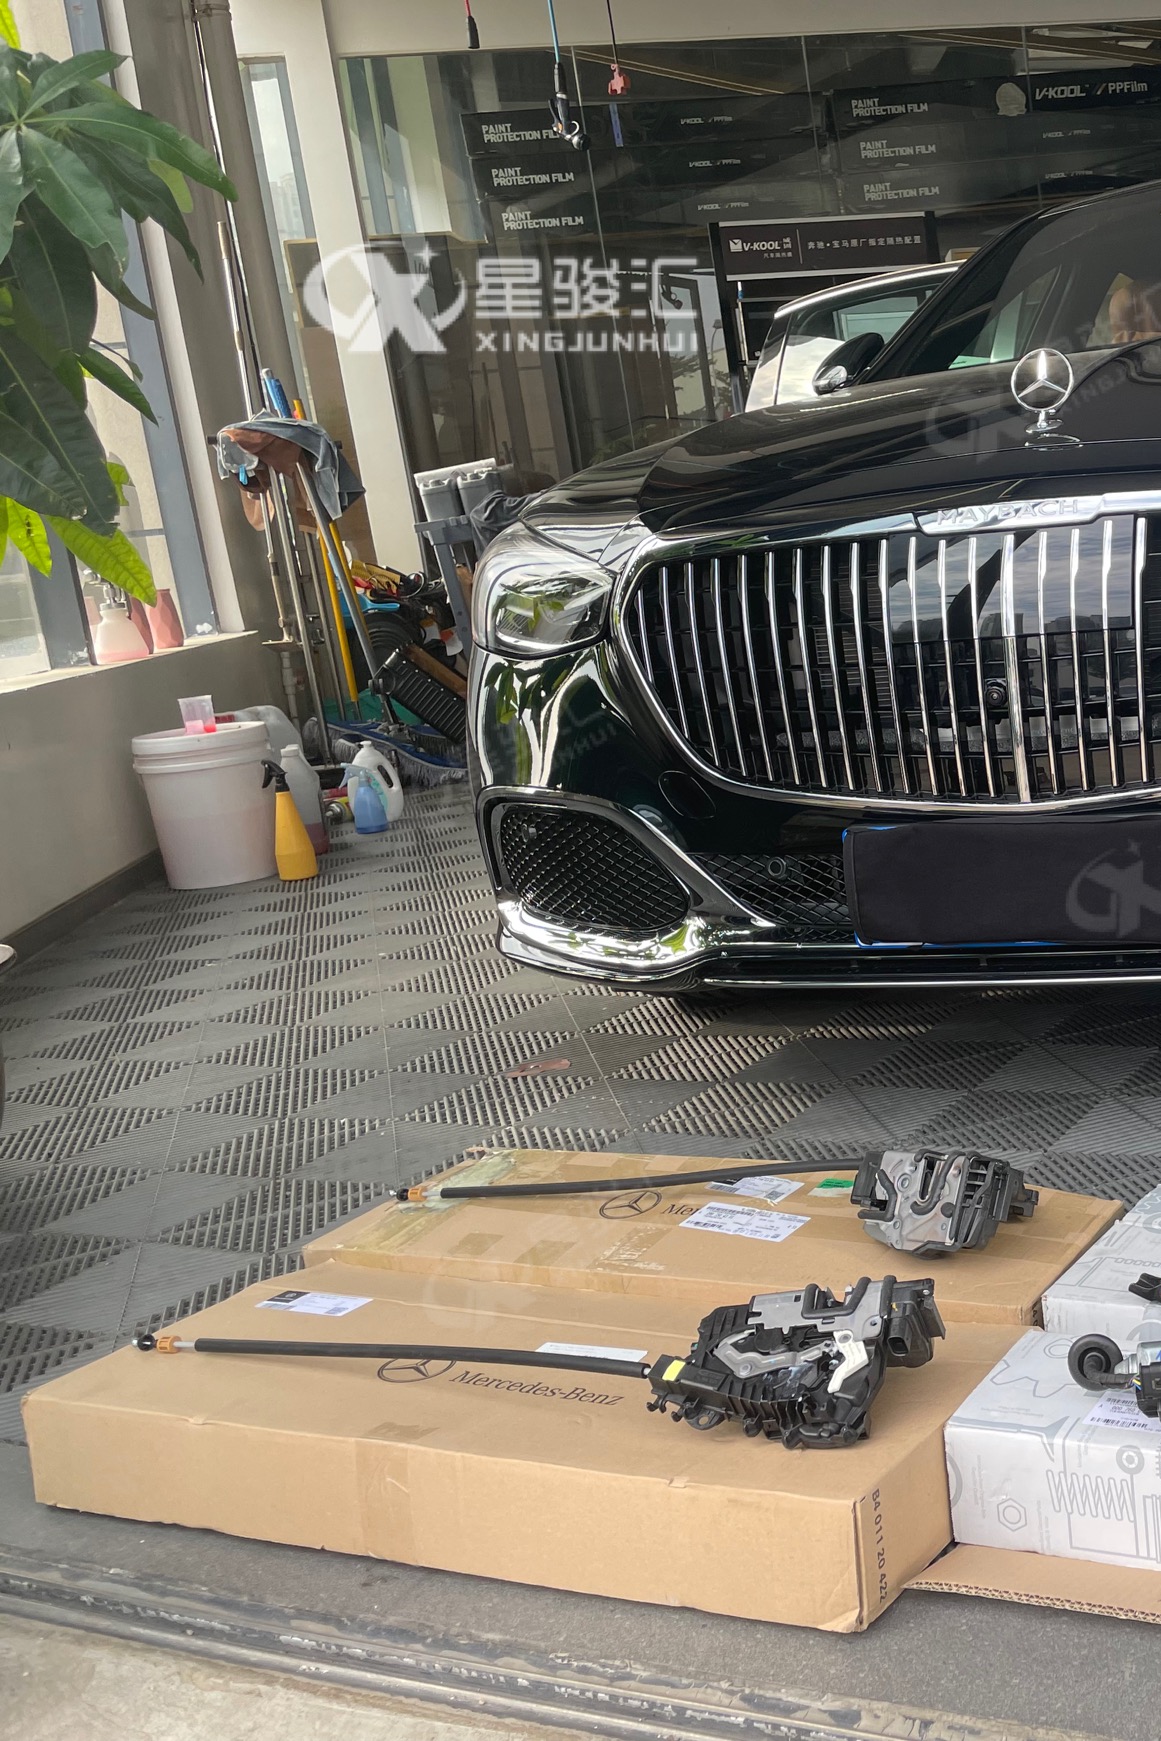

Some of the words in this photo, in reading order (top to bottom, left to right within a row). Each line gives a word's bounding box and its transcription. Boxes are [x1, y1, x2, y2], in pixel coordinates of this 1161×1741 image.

[1035, 84, 1086, 100] V-KOOL
[851, 97, 879, 108] PAINT
[852, 105, 906, 117] PROTECTION
[908, 103, 928, 113] FILM
[482, 123, 511, 134] PAINT
[484, 130, 540, 143] PROTECTION
[860, 139, 887, 150] PAINT
[861, 146, 914, 159] PROTECTION
[916, 144, 936, 155] FILM
[491, 167, 521, 178] PAINT
[493, 174, 550, 187] PROTECTION
[552, 172, 574, 184] FILM
[863, 182, 890, 193] PAINT
[865, 189, 917, 202] PROTECTION
[919, 186, 939, 197] FILM
[502, 211, 532, 222] PAINT
[503, 217, 560, 230] PROTECTION
[561, 216, 584, 227] FILM
[743, 240, 781, 251] V-KOOL
[937, 500, 1078, 526] MAYBACH
[449, 1370, 624, 1406] Mercedes-Benz
[872, 1488, 881, 1511] B4
[875, 1514, 883, 1545] 011
[877, 1547, 886, 1570] 20
[879, 1573, 888, 1603] 422
